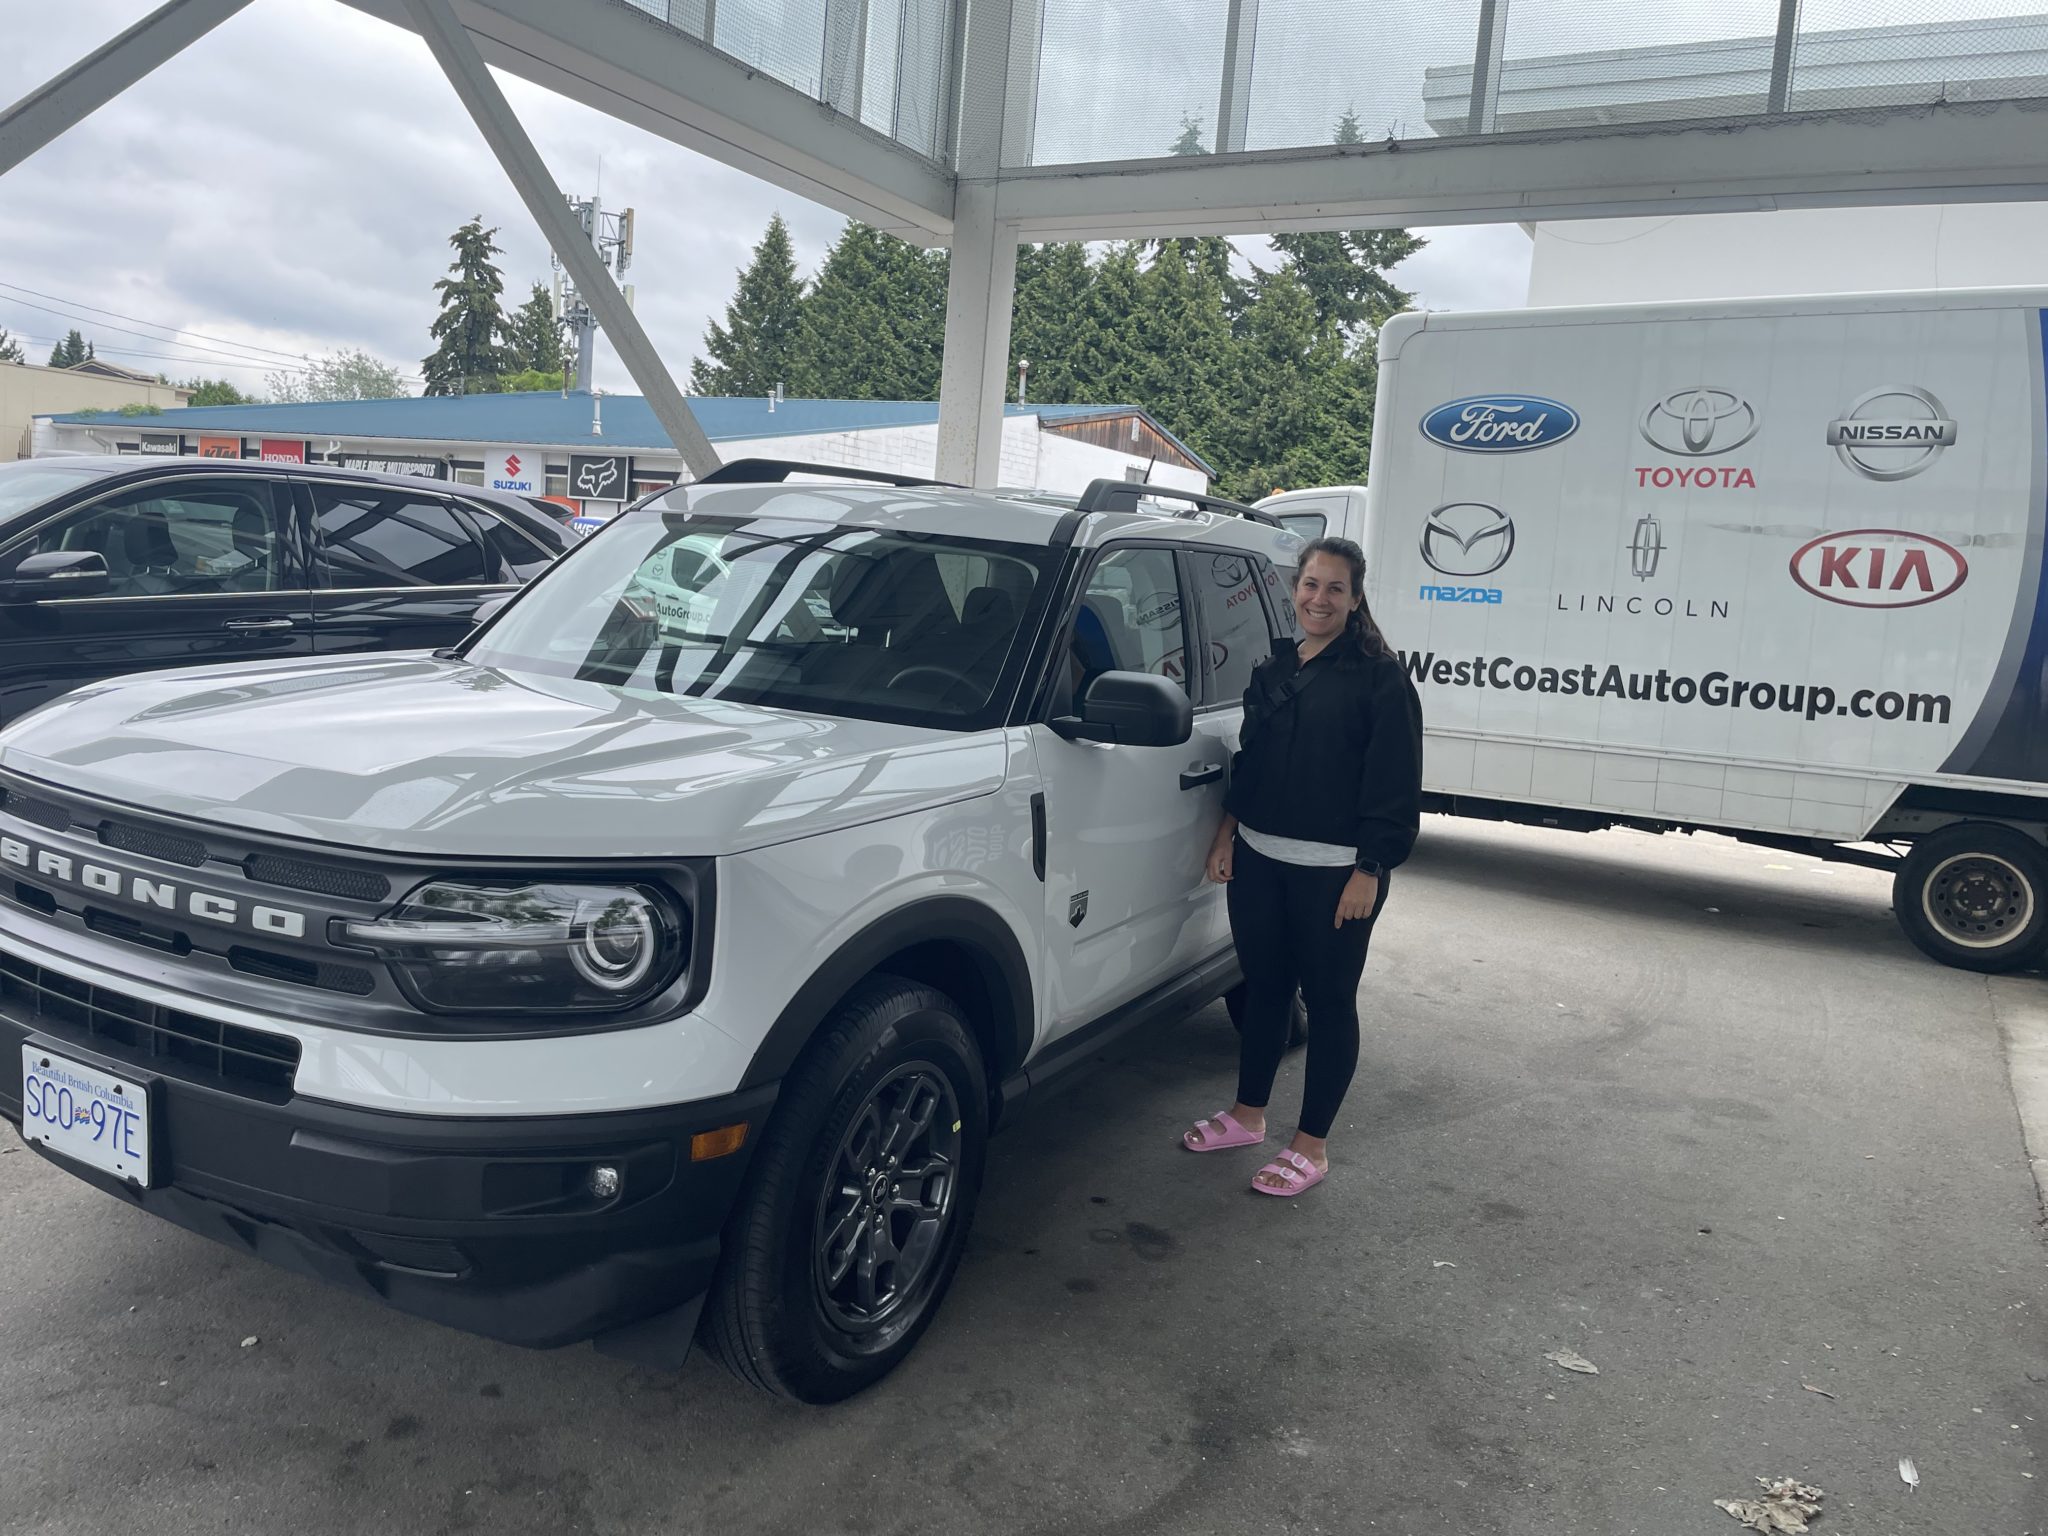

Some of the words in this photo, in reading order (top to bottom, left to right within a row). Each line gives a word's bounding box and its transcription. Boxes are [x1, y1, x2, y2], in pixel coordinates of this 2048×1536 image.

[1450, 404, 1544, 443] Ford
[1838, 424, 1944, 441] NISSAN
[141, 441, 177, 453] Kawasaki
[204, 445, 238, 458] KTM
[263, 453, 300, 464] HONDA
[345, 459, 367, 471] MAPLE
[367, 460, 386, 473] RIDGE
[386, 461, 436, 477] MOTORSPORTS
[493, 480, 531, 492] SUZUKI
[1635, 467, 1756, 489] TOYOTA
[1819, 546, 1934, 593] KIA
[1419, 585, 1503, 604] mazda
[1557, 593, 1729, 618] LINCOLN
[1397, 650, 1952, 724] WestCoastAutoGroup.com
[1, 837, 306, 938] BRONCO
[31, 1061, 66, 1084] Beautiful
[68, 1075, 93, 1095] British
[94, 1085, 134, 1110] Columbia
[90, 1100, 140, 1159] 97E
